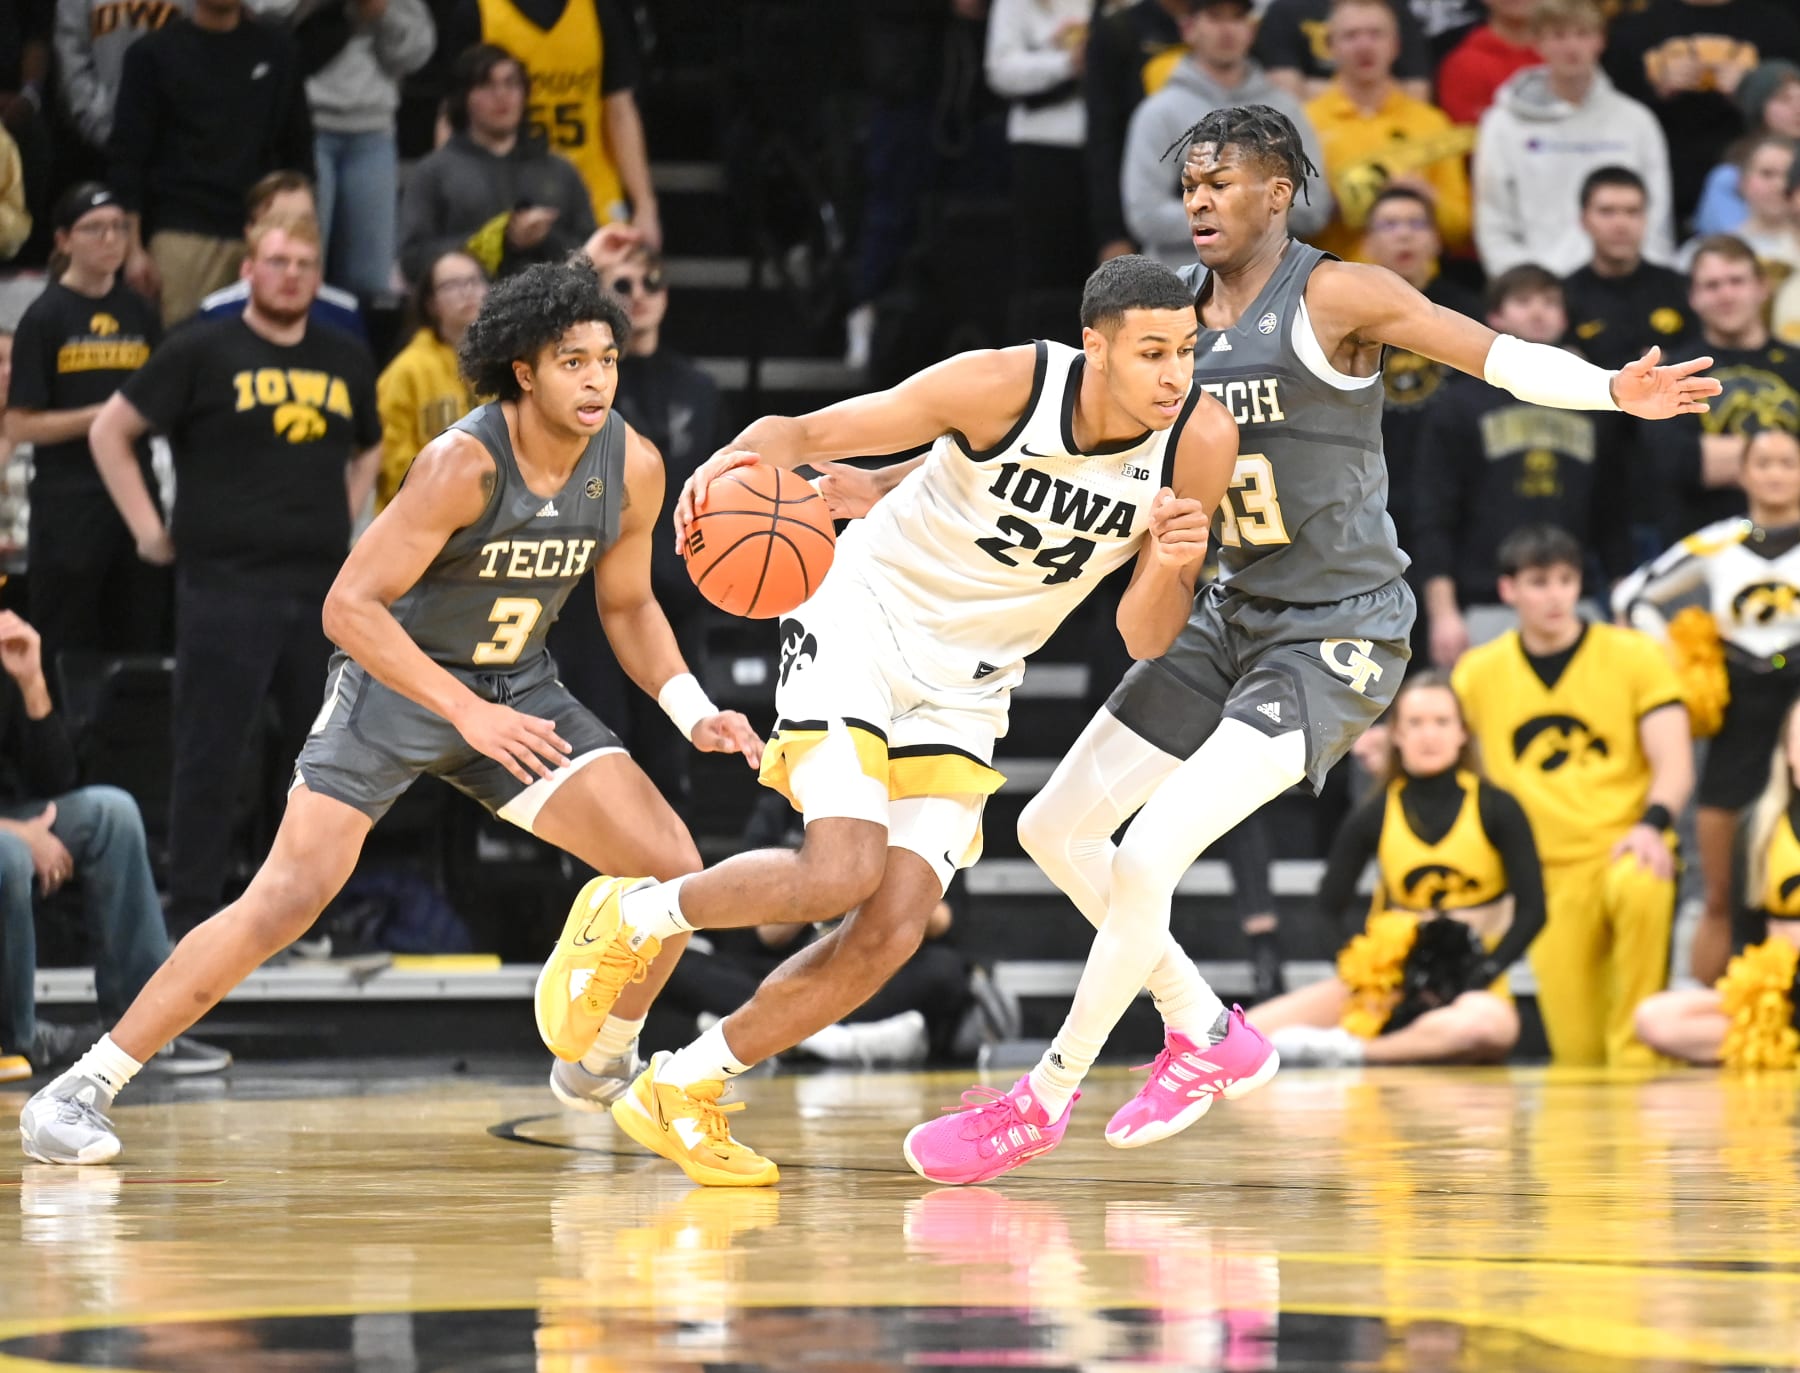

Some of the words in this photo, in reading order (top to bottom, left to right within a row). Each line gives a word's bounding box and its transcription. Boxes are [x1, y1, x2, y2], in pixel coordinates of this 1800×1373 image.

[232, 366, 354, 421] IOWA
[988, 461, 1138, 538] IOWA
[478, 538, 597, 580] TECH
[973, 513, 1097, 586] 24
[471, 596, 544, 665] 3
